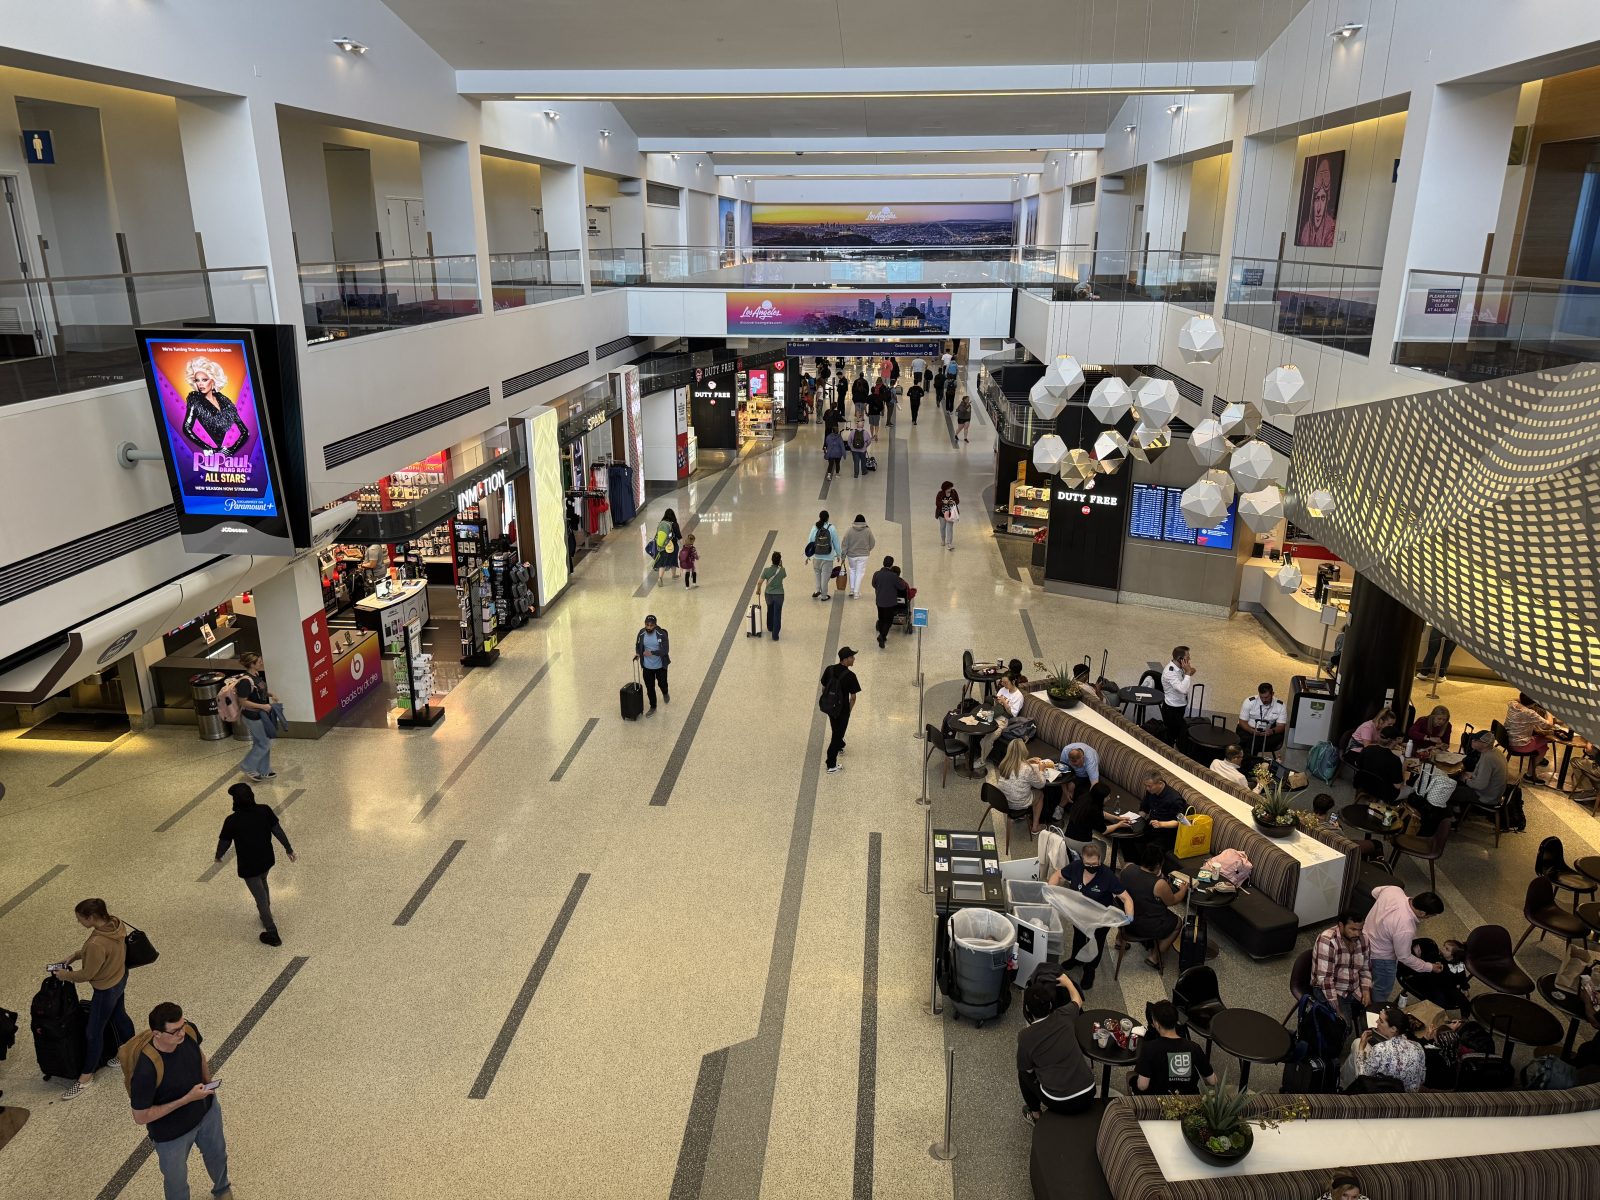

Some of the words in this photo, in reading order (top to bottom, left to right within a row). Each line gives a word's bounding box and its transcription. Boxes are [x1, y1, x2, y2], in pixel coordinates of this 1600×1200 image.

[740, 305, 752, 318] Los
[752, 305, 782, 320] Angeles
[704, 366, 720, 378] DUTY
[721, 361, 735, 373] FREE
[714, 391, 731, 399] FREE
[205, 473, 219, 483] ALL
[220, 473, 246, 484] STARS
[1058, 491, 1086, 503] DUTY
[1089, 494, 1118, 506] FREE
[341, 691, 357, 707] beats
